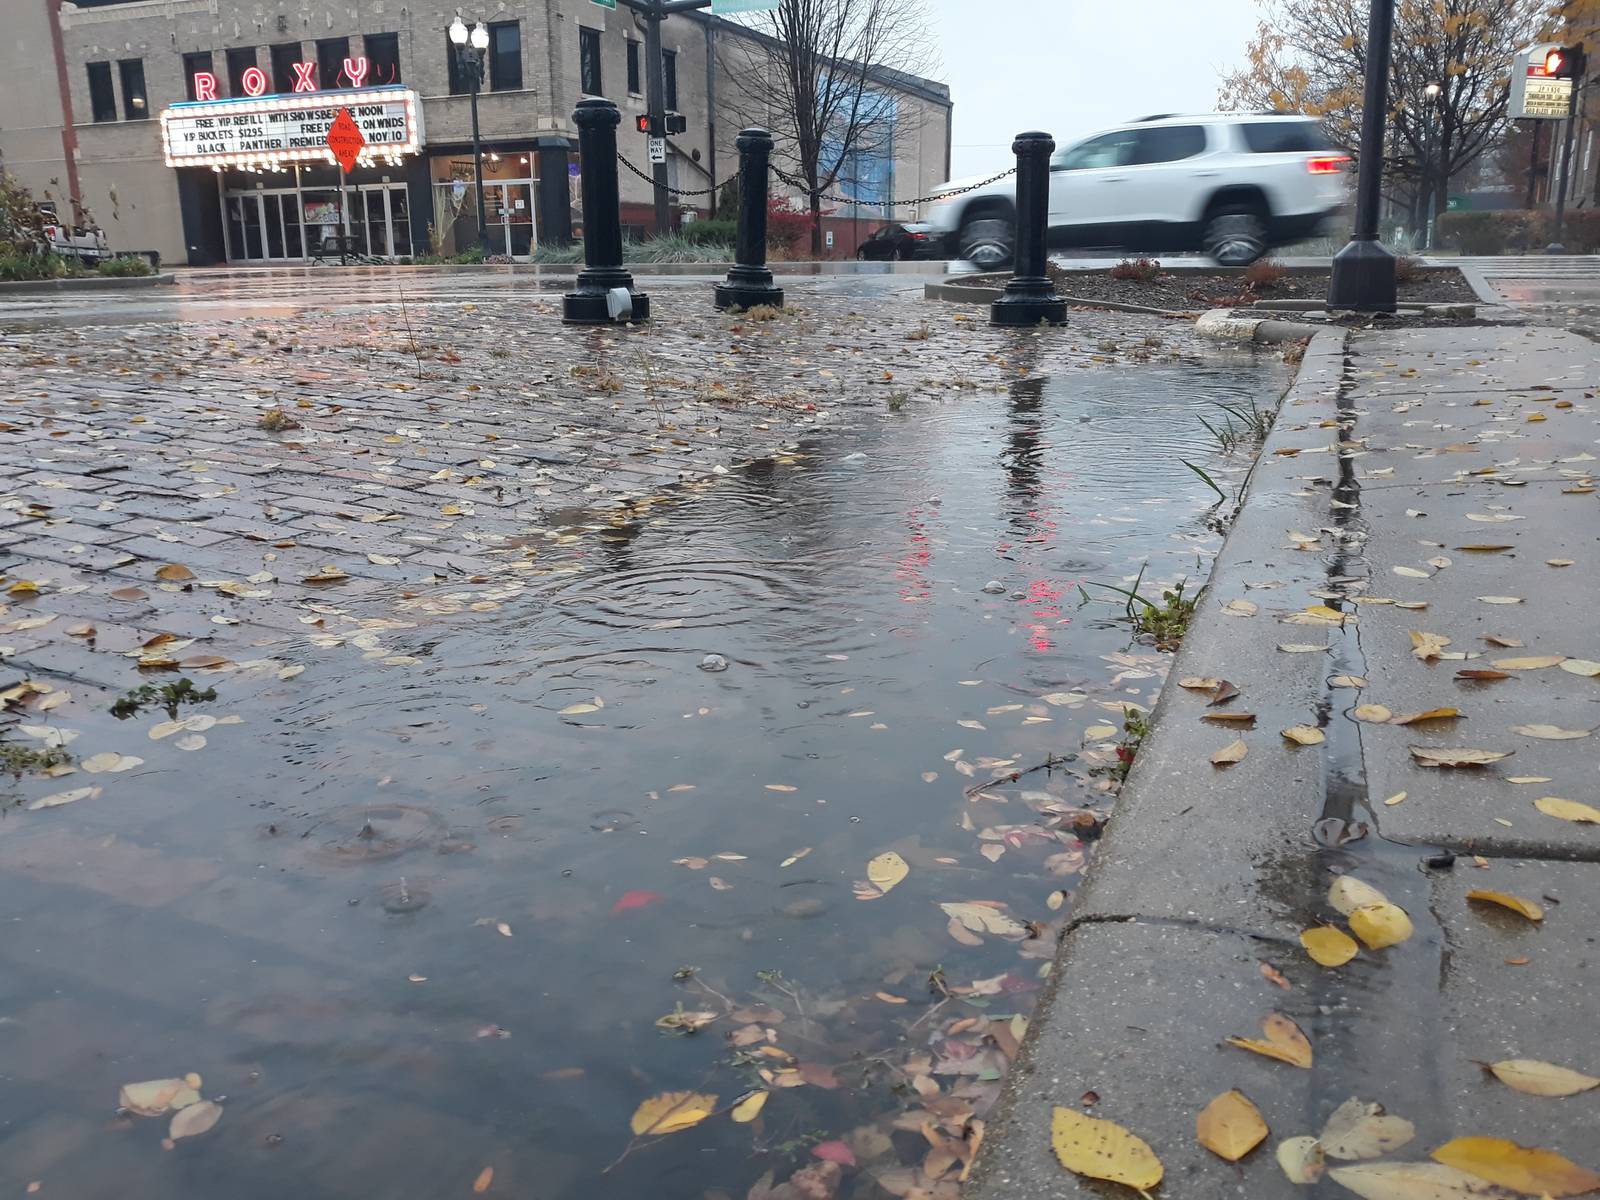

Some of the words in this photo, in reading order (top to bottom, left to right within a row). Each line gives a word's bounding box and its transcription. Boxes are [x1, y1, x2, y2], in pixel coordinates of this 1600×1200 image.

[194, 57, 367, 101] ROXY
[195, 118, 214, 128] FREE
[218, 117, 231, 127] VIP
[233, 114, 263, 126] REFILL
[268, 112, 289, 123] WITH
[289, 110, 321, 121] SHOWS
[358, 106, 383, 117] NOON
[198, 130, 234, 141] BUCKETS
[300, 123, 323, 134] FREE
[363, 119, 376, 130] ON
[197, 143, 226, 154] BLACK
[240, 139, 282, 151] PANTHER
[369, 131, 388, 142] NOV
[392, 130, 402, 141] 10
